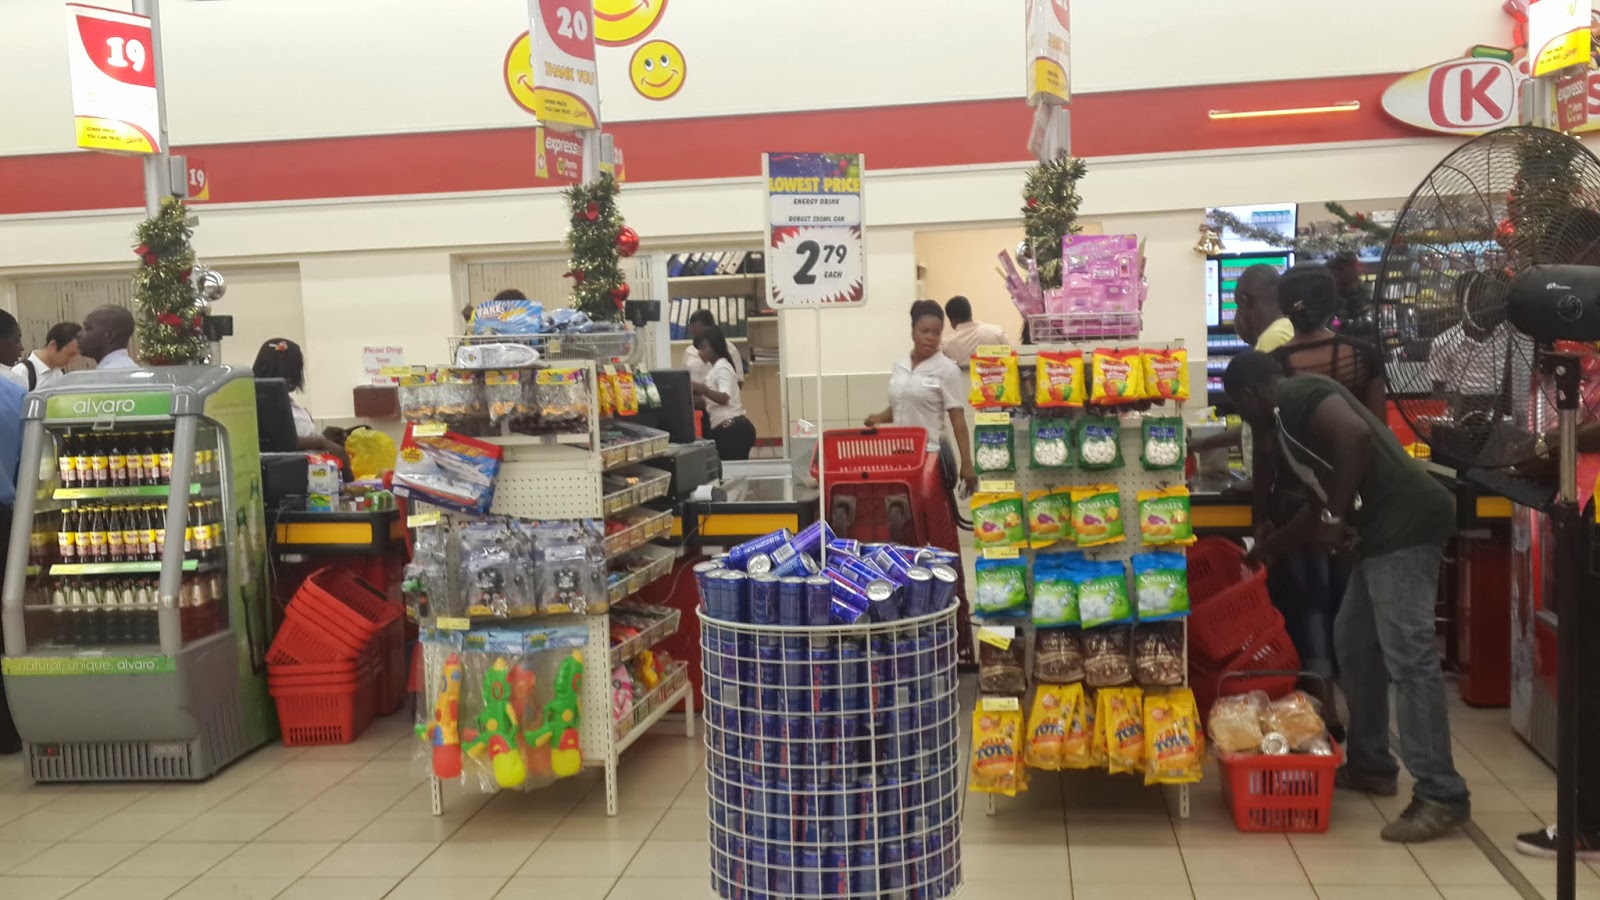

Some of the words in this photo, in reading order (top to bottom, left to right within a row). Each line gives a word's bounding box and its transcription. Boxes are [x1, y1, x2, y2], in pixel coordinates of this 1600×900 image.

[556, 6, 588, 41] 20
[106, 36, 146, 72] 19
[544, 61, 575, 82] THANK
[576, 67, 596, 87] YOU
[545, 137, 579, 156] express
[188, 167, 205, 187] 19
[769, 176, 820, 193] LOWEST
[823, 176, 860, 193] PRICE
[823, 271, 843, 279] EACH
[364, 346, 385, 354] Please
[386, 346, 403, 355] Drop
[73, 397, 135, 414] alvaro
